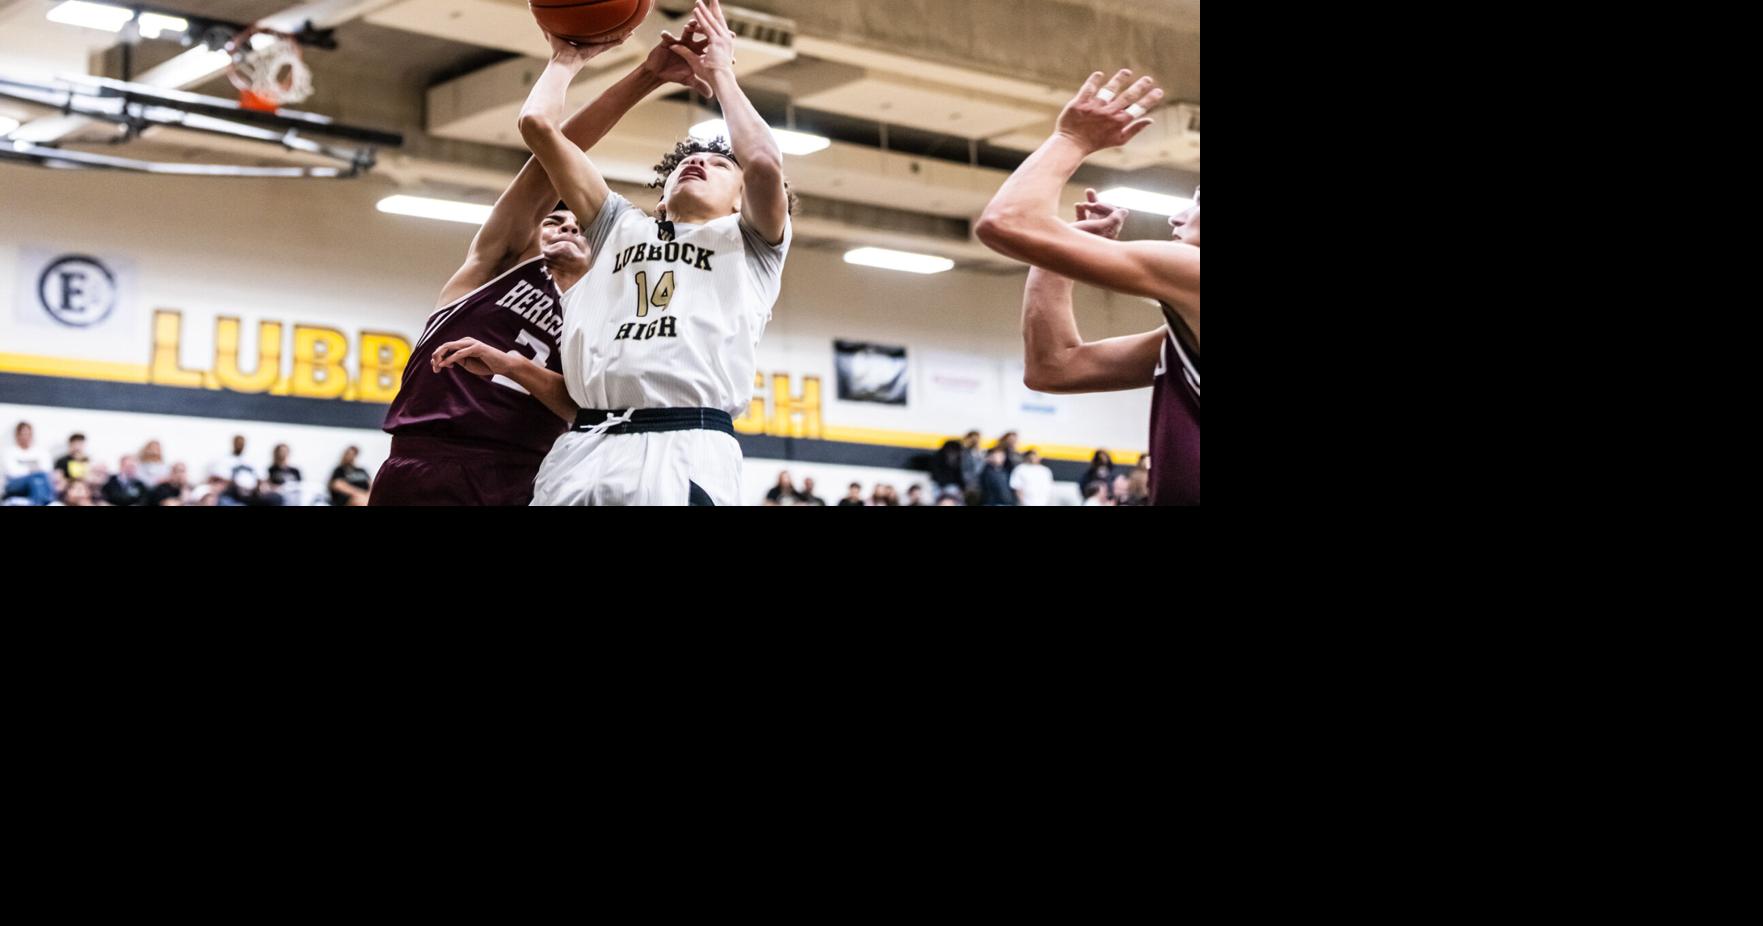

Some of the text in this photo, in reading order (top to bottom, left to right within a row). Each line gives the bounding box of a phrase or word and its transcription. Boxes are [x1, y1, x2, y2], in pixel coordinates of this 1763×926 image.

[612, 242, 714, 274] LUBBOCK
[634, 270, 675, 317] 14
[614, 315, 677, 340] HIGH
[152, 309, 412, 404] LUBB
